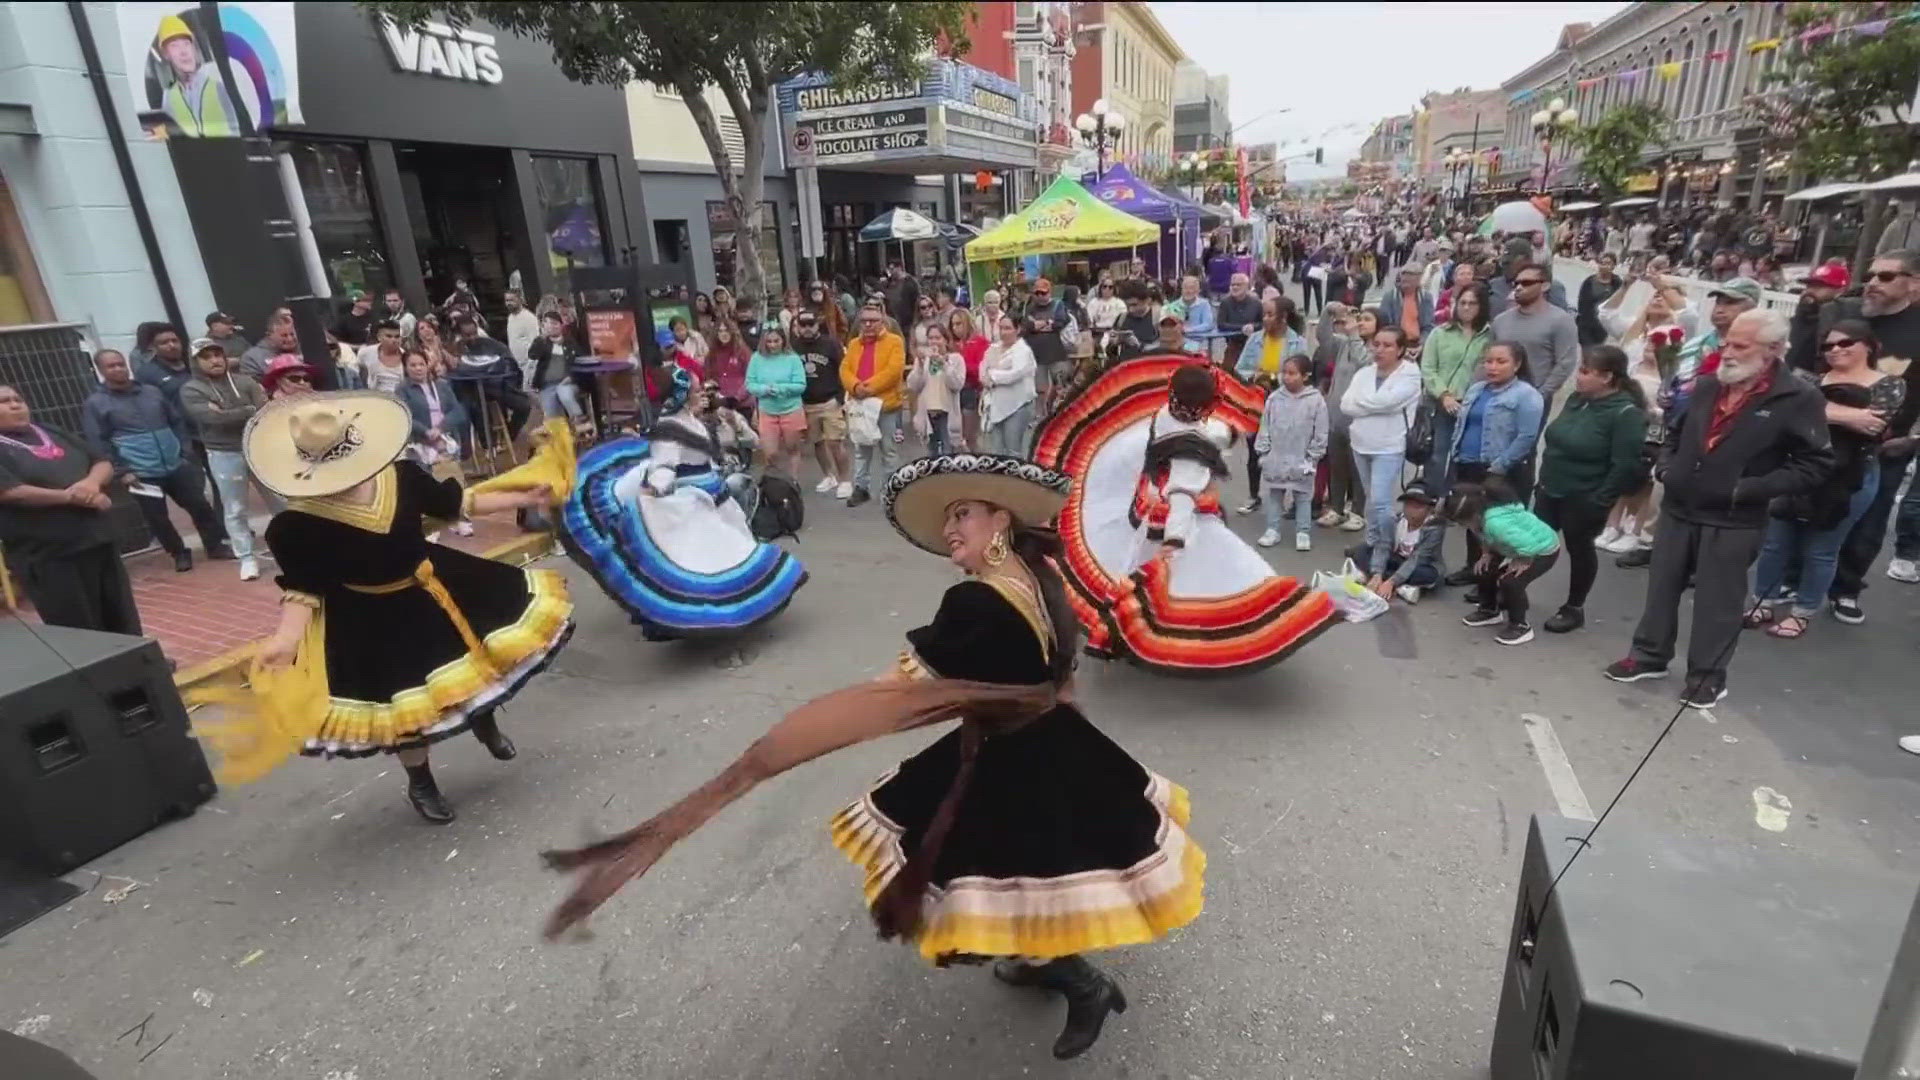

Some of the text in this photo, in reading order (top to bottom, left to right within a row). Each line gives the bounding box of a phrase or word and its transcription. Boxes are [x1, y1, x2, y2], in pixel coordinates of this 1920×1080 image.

[379, 12, 503, 84] VANS
[817, 113, 906, 133] ICE CREAM AND
[815, 132, 920, 155] HOCOLATE SHOP
